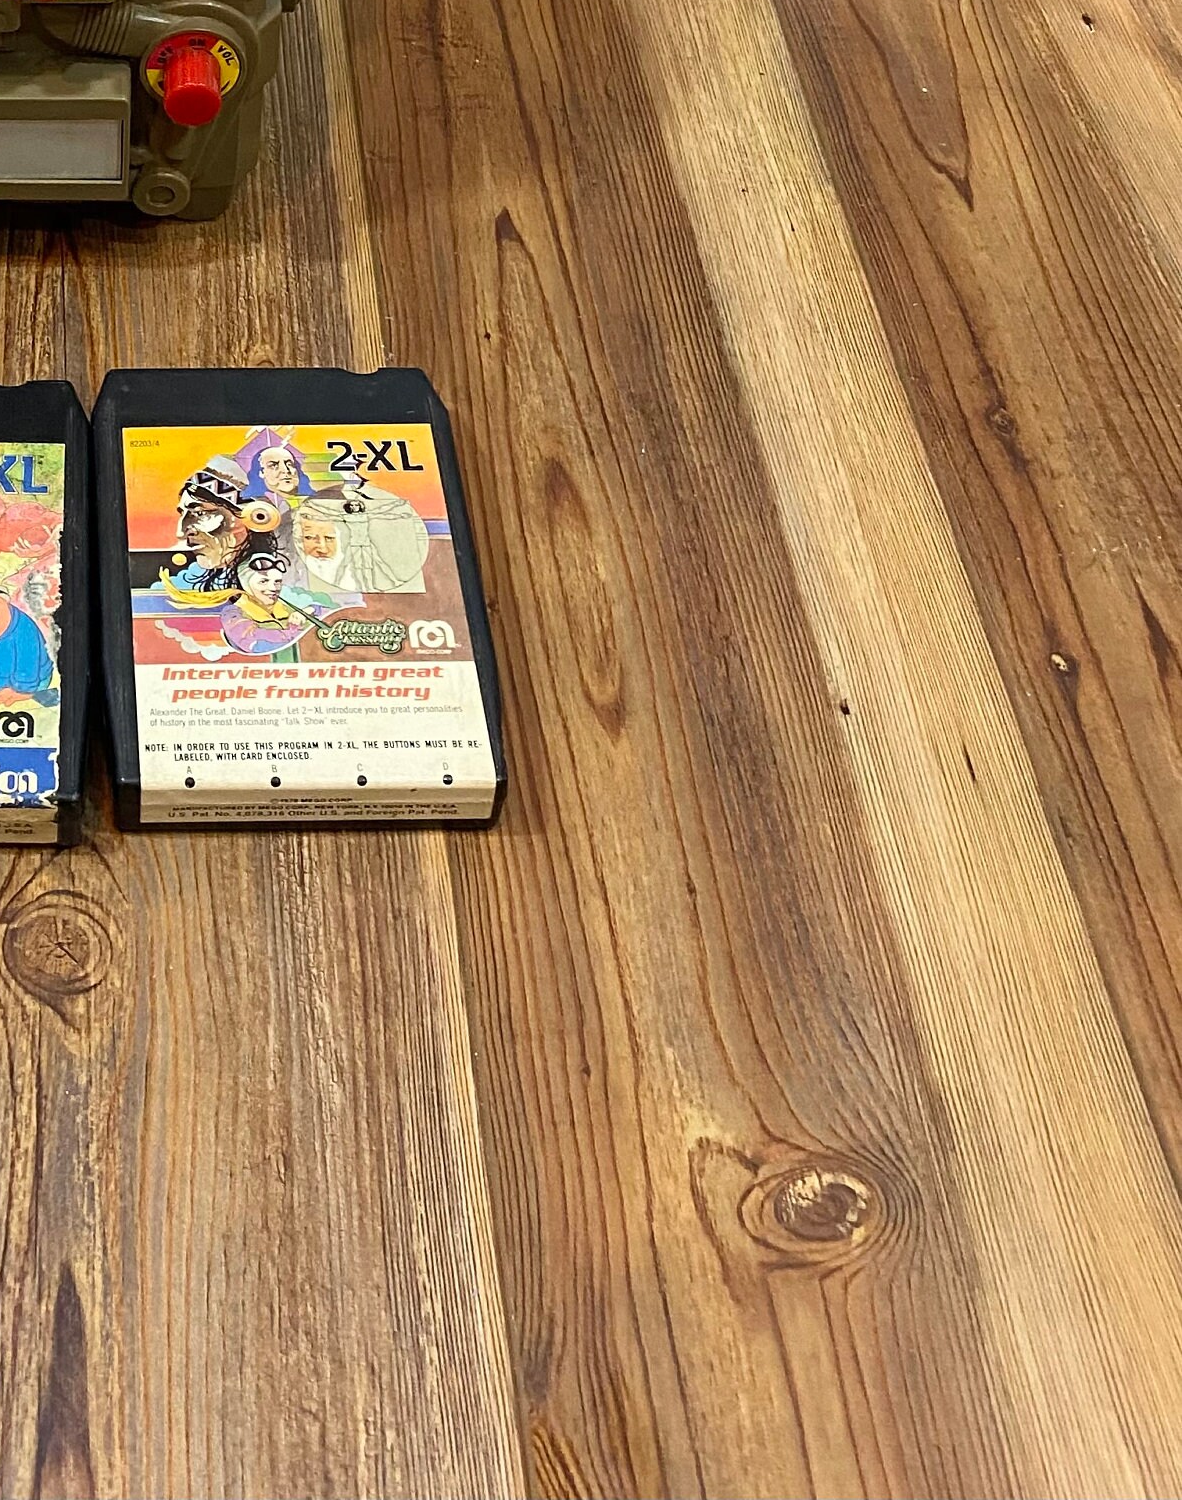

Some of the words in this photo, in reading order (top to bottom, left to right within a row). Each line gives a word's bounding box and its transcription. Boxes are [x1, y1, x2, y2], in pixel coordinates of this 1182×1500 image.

[217, 45, 234, 66] VOL
[129, 440, 160, 448] 82203/4
[326, 440, 424, 472] 2-XL
[162, 666, 299, 681] Interviews
[307, 665, 366, 679] with
[371, 665, 445, 682] great
[171, 685, 258, 703] people
[264, 685, 329, 699] from
[335, 684, 432, 701] history
[149, 707, 187, 717] Alexander
[189, 707, 203, 716] The
[231, 706, 256, 715] Daniel
[287, 706, 300, 715] Let
[326, 705, 363, 715] introduce
[364, 707, 378, 716] you
[380, 706, 388, 714] to
[390, 705, 411, 715] great
[413, 704, 463, 715] personalities
[149, 718, 158, 727] of
[160, 717, 186, 727] history
[188, 718, 196, 727] in
[198, 717, 211, 726] the
[213, 717, 233, 726] most
[235, 717, 279, 727] fascinating
[144, 743, 169, 752] NOTE:
[173, 743, 182, 751] IN
[187, 742, 215, 751] ORDER
[220, 742, 230, 751] TO
[234, 742, 251, 751] USE
[255, 741, 274, 751] THIS
[278, 741, 319, 750] PROGRAM
[324, 741, 333, 749] IN
[363, 741, 379, 749] THE
[384, 740, 421, 749] BUTTONS
[425, 740, 448, 748] MUST
[452, 740, 463, 748] BE
[468, 740, 482, 748] RE-
[216, 752, 237, 761] WITH
[241, 752, 263, 761] CARD
[266, 751, 313, 761] ENCLOSED.
[186, 766, 193, 774] A
[271, 764, 278, 773] B
[356, 763, 364, 772] C
[442, 762, 449, 771] D
[367, 809, 405, 817] Foreign
